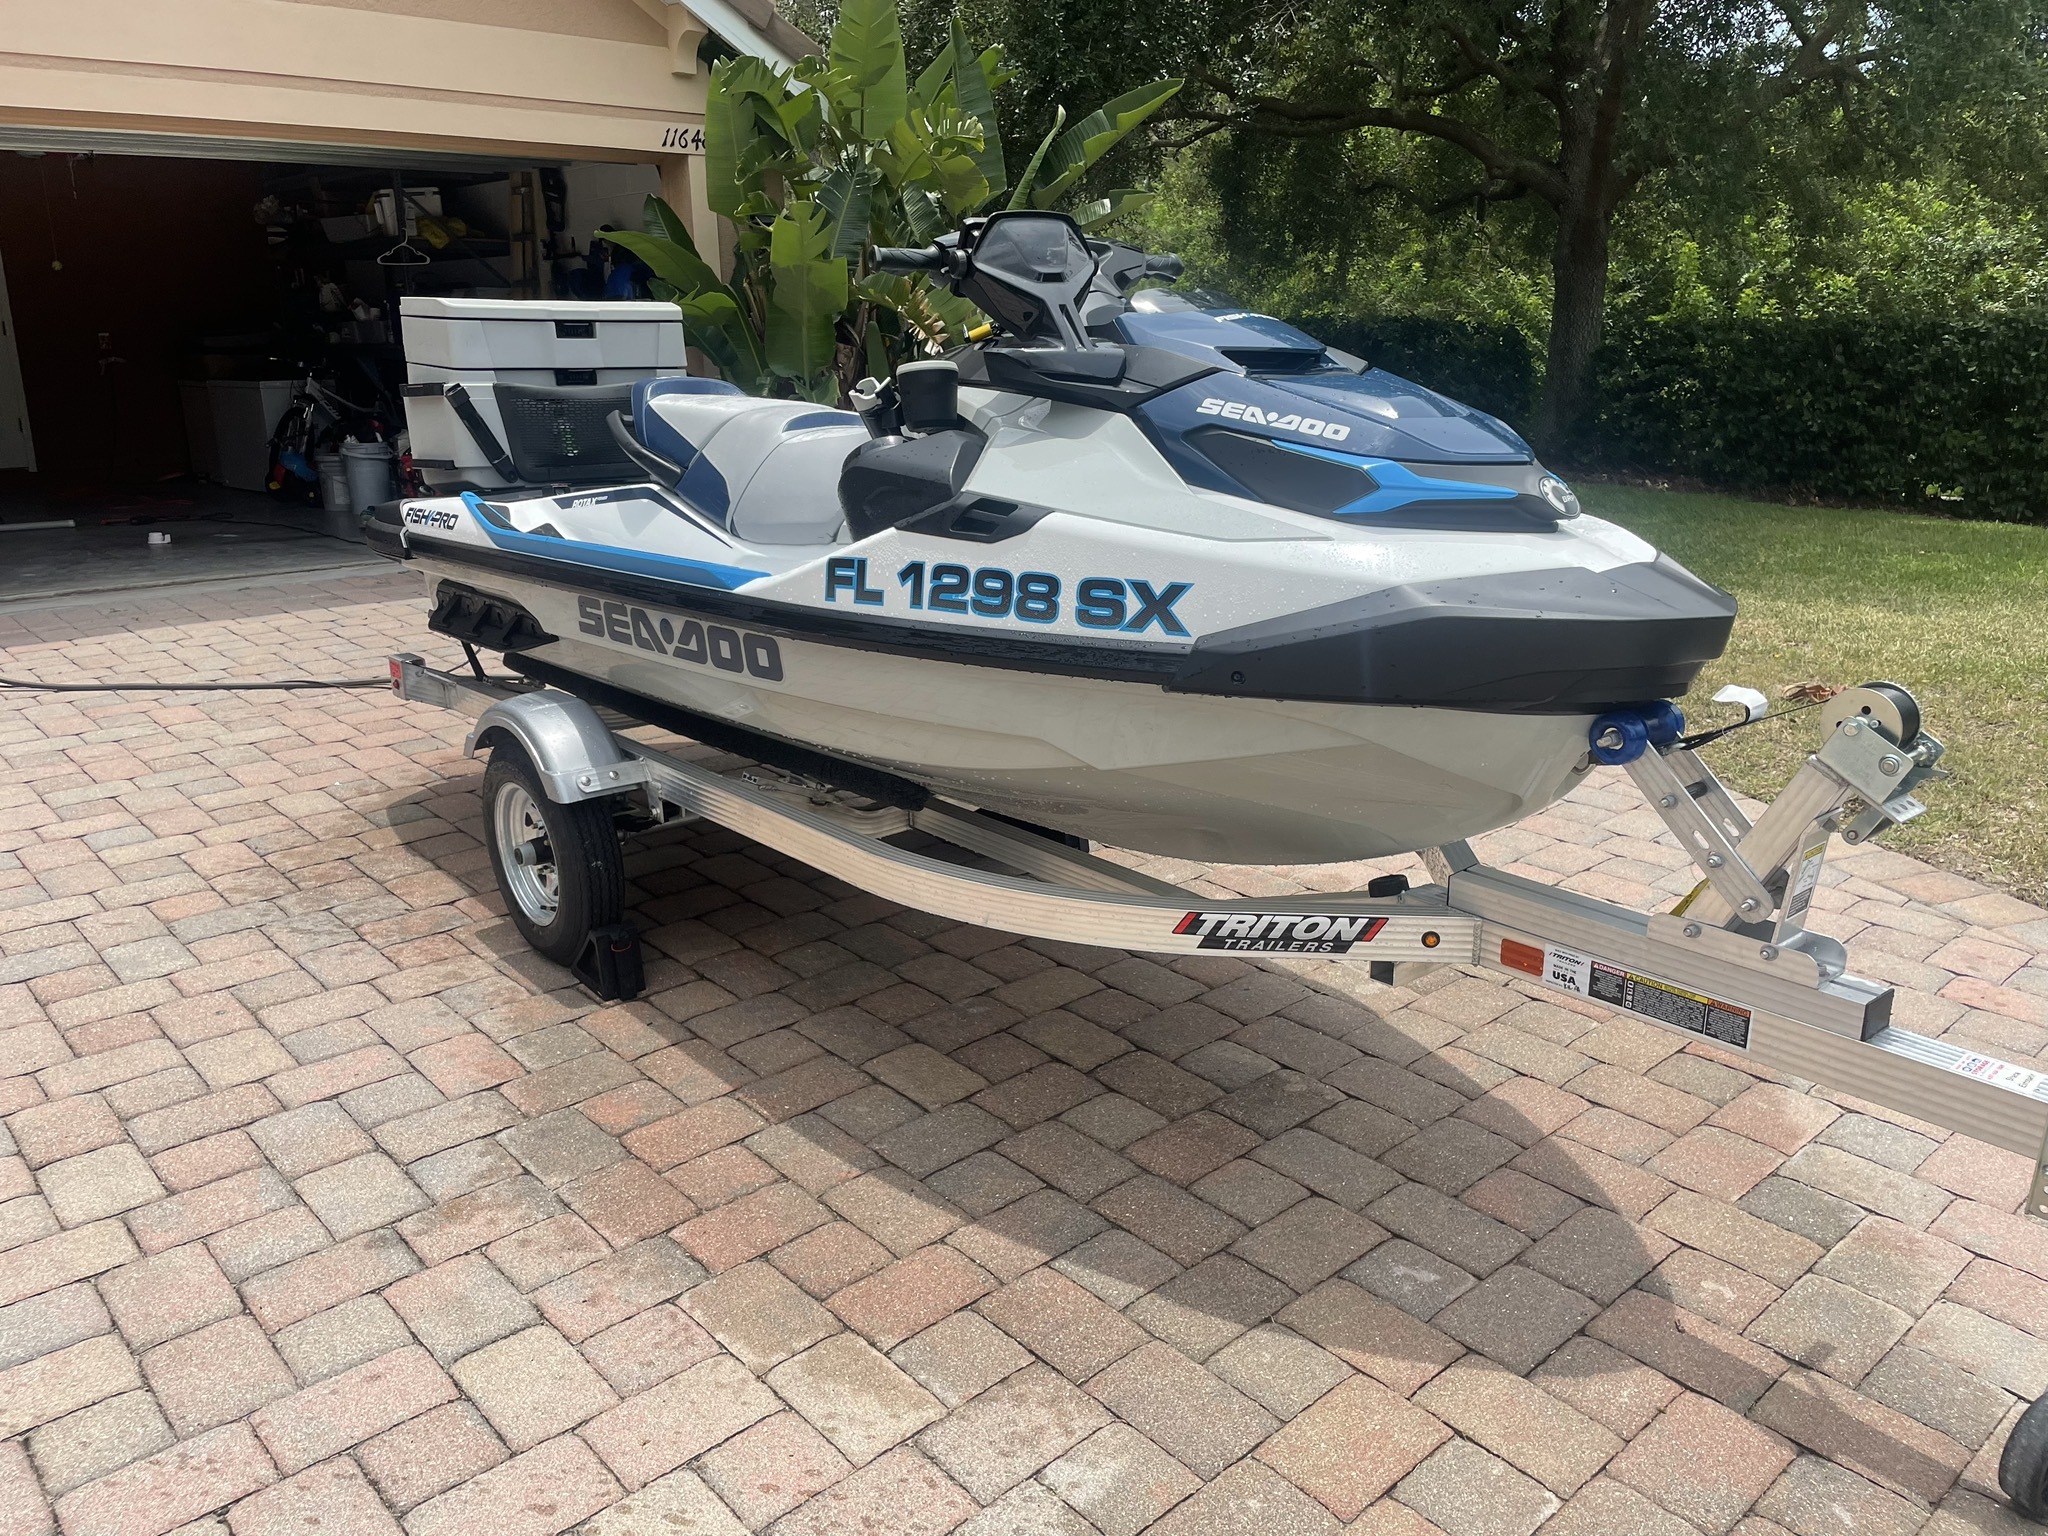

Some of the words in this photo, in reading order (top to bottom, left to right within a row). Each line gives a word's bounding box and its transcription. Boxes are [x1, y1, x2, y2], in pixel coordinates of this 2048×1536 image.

[661, 127, 706, 152] 1164
[825, 556, 885, 606] FL
[896, 560, 1061, 625] 1298
[1075, 576, 1194, 638] SX
[1195, 913, 1370, 941] TRITON
[1223, 938, 1334, 953] TRAILERS
[1552, 952, 1582, 966] TRITON
[1552, 971, 1576, 985] USA
[1599, 965, 1625, 977] DANGER
[1635, 975, 1663, 989] CAUTION
